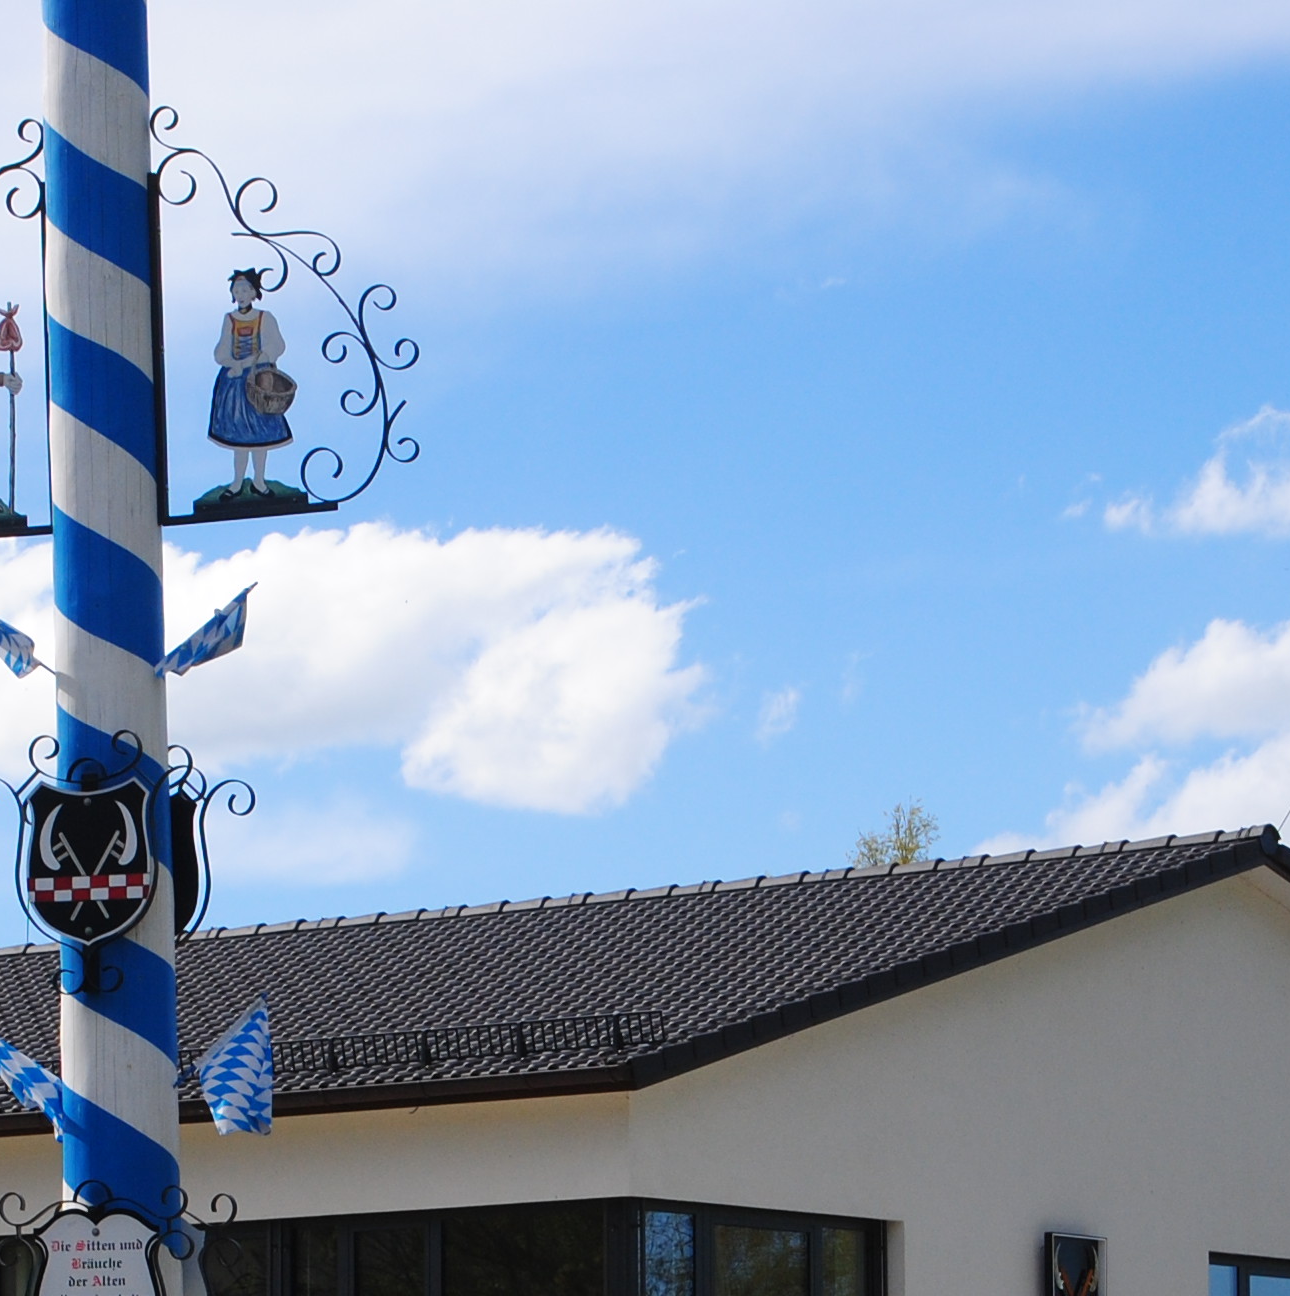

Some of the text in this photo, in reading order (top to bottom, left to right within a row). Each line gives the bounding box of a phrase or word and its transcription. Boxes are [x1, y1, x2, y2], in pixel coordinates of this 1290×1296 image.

[51, 1238, 143, 1252] Die Sitten und
[71, 1257, 123, 1271] Bräuche
[68, 1275, 126, 1287] der Alten
